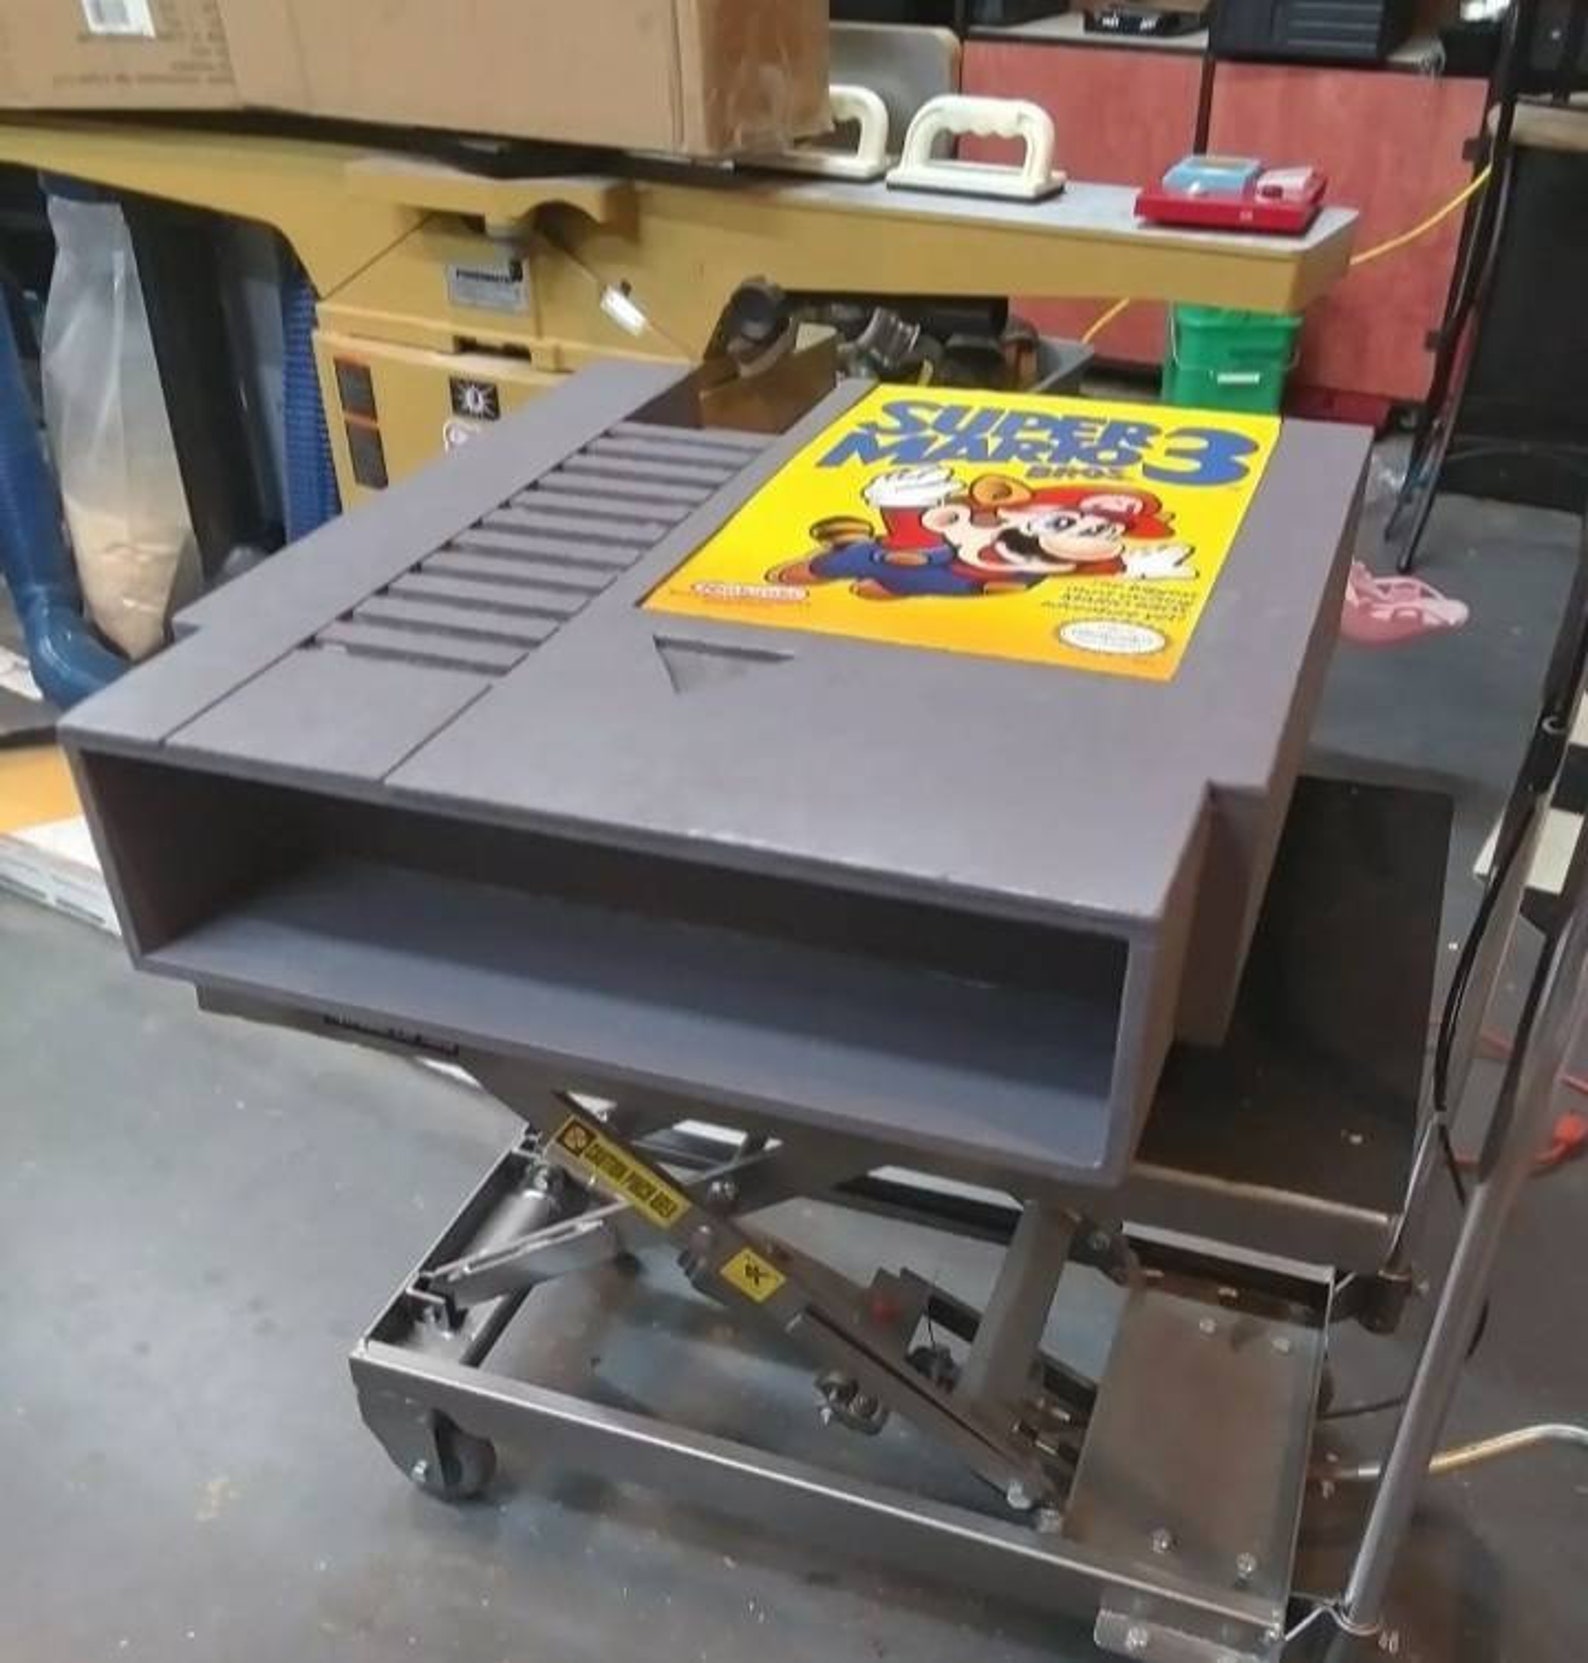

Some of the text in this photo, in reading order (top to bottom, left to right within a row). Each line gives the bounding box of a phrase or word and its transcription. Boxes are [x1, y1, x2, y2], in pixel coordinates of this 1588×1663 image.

[857, 400, 1163, 449] SUPER
[815, 427, 1259, 486] MARIO 3
[583, 1142, 629, 1180] CAUTION
